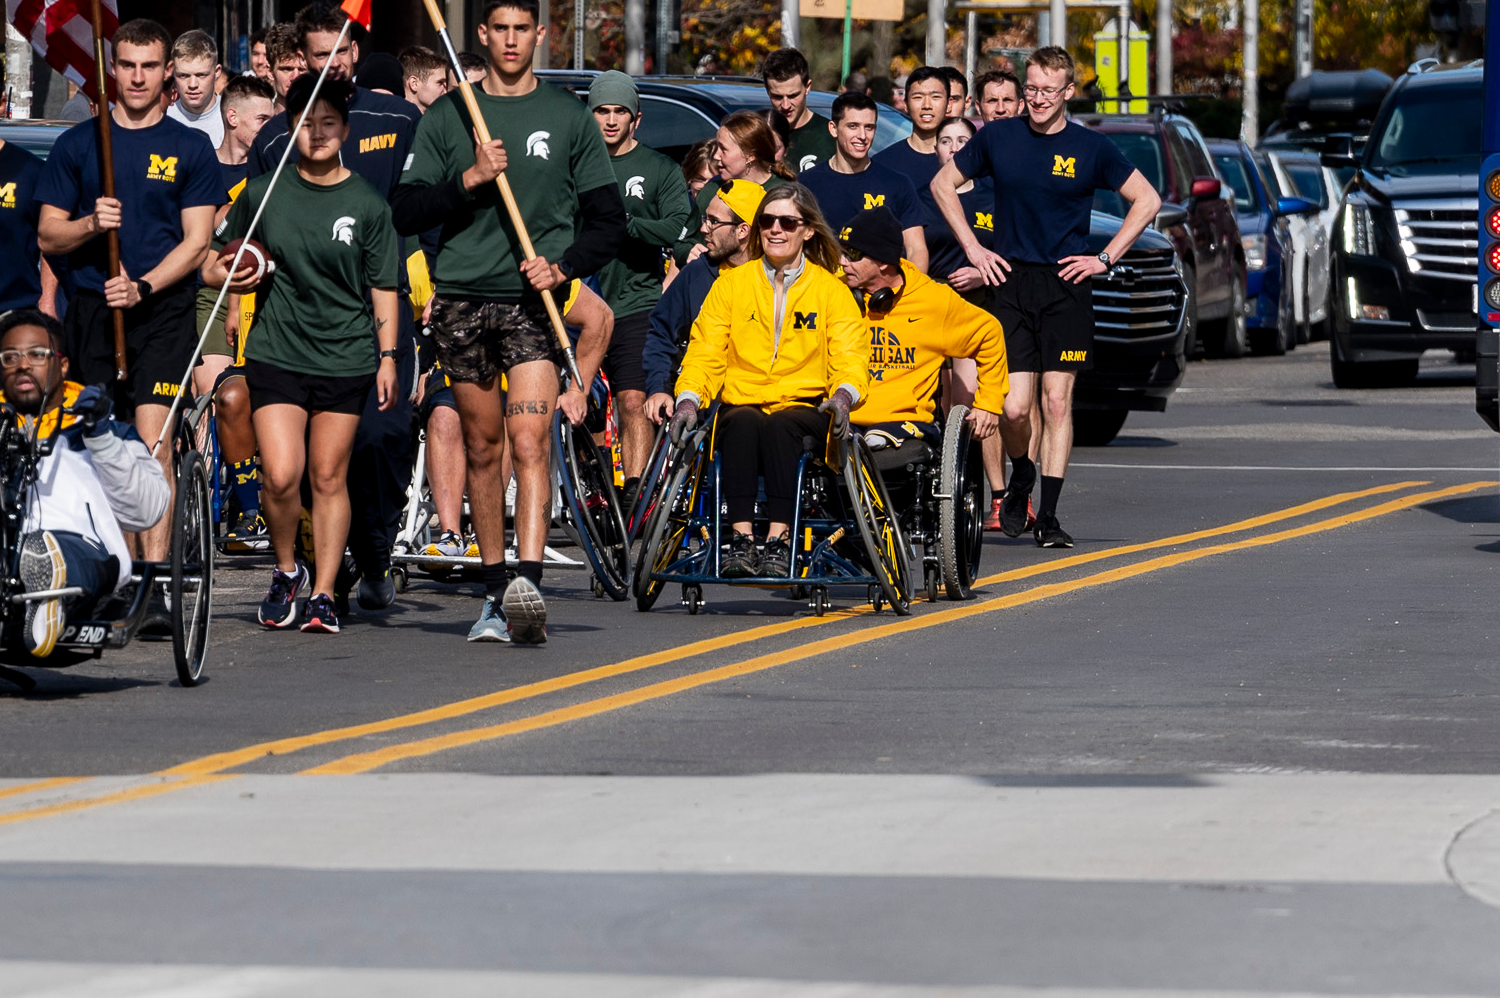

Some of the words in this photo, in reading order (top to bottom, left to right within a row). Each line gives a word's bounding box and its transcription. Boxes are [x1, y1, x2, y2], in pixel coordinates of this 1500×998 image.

[359, 133, 397, 153] NAVY
[148, 154, 178, 176] M
[1053, 154, 1076, 174] M
[863, 193, 885, 210] M
[975, 212, 993, 228] M
[793, 311, 818, 330] M
[869, 346, 916, 364] HIGAN
[1060, 351, 1087, 362] ARMY
